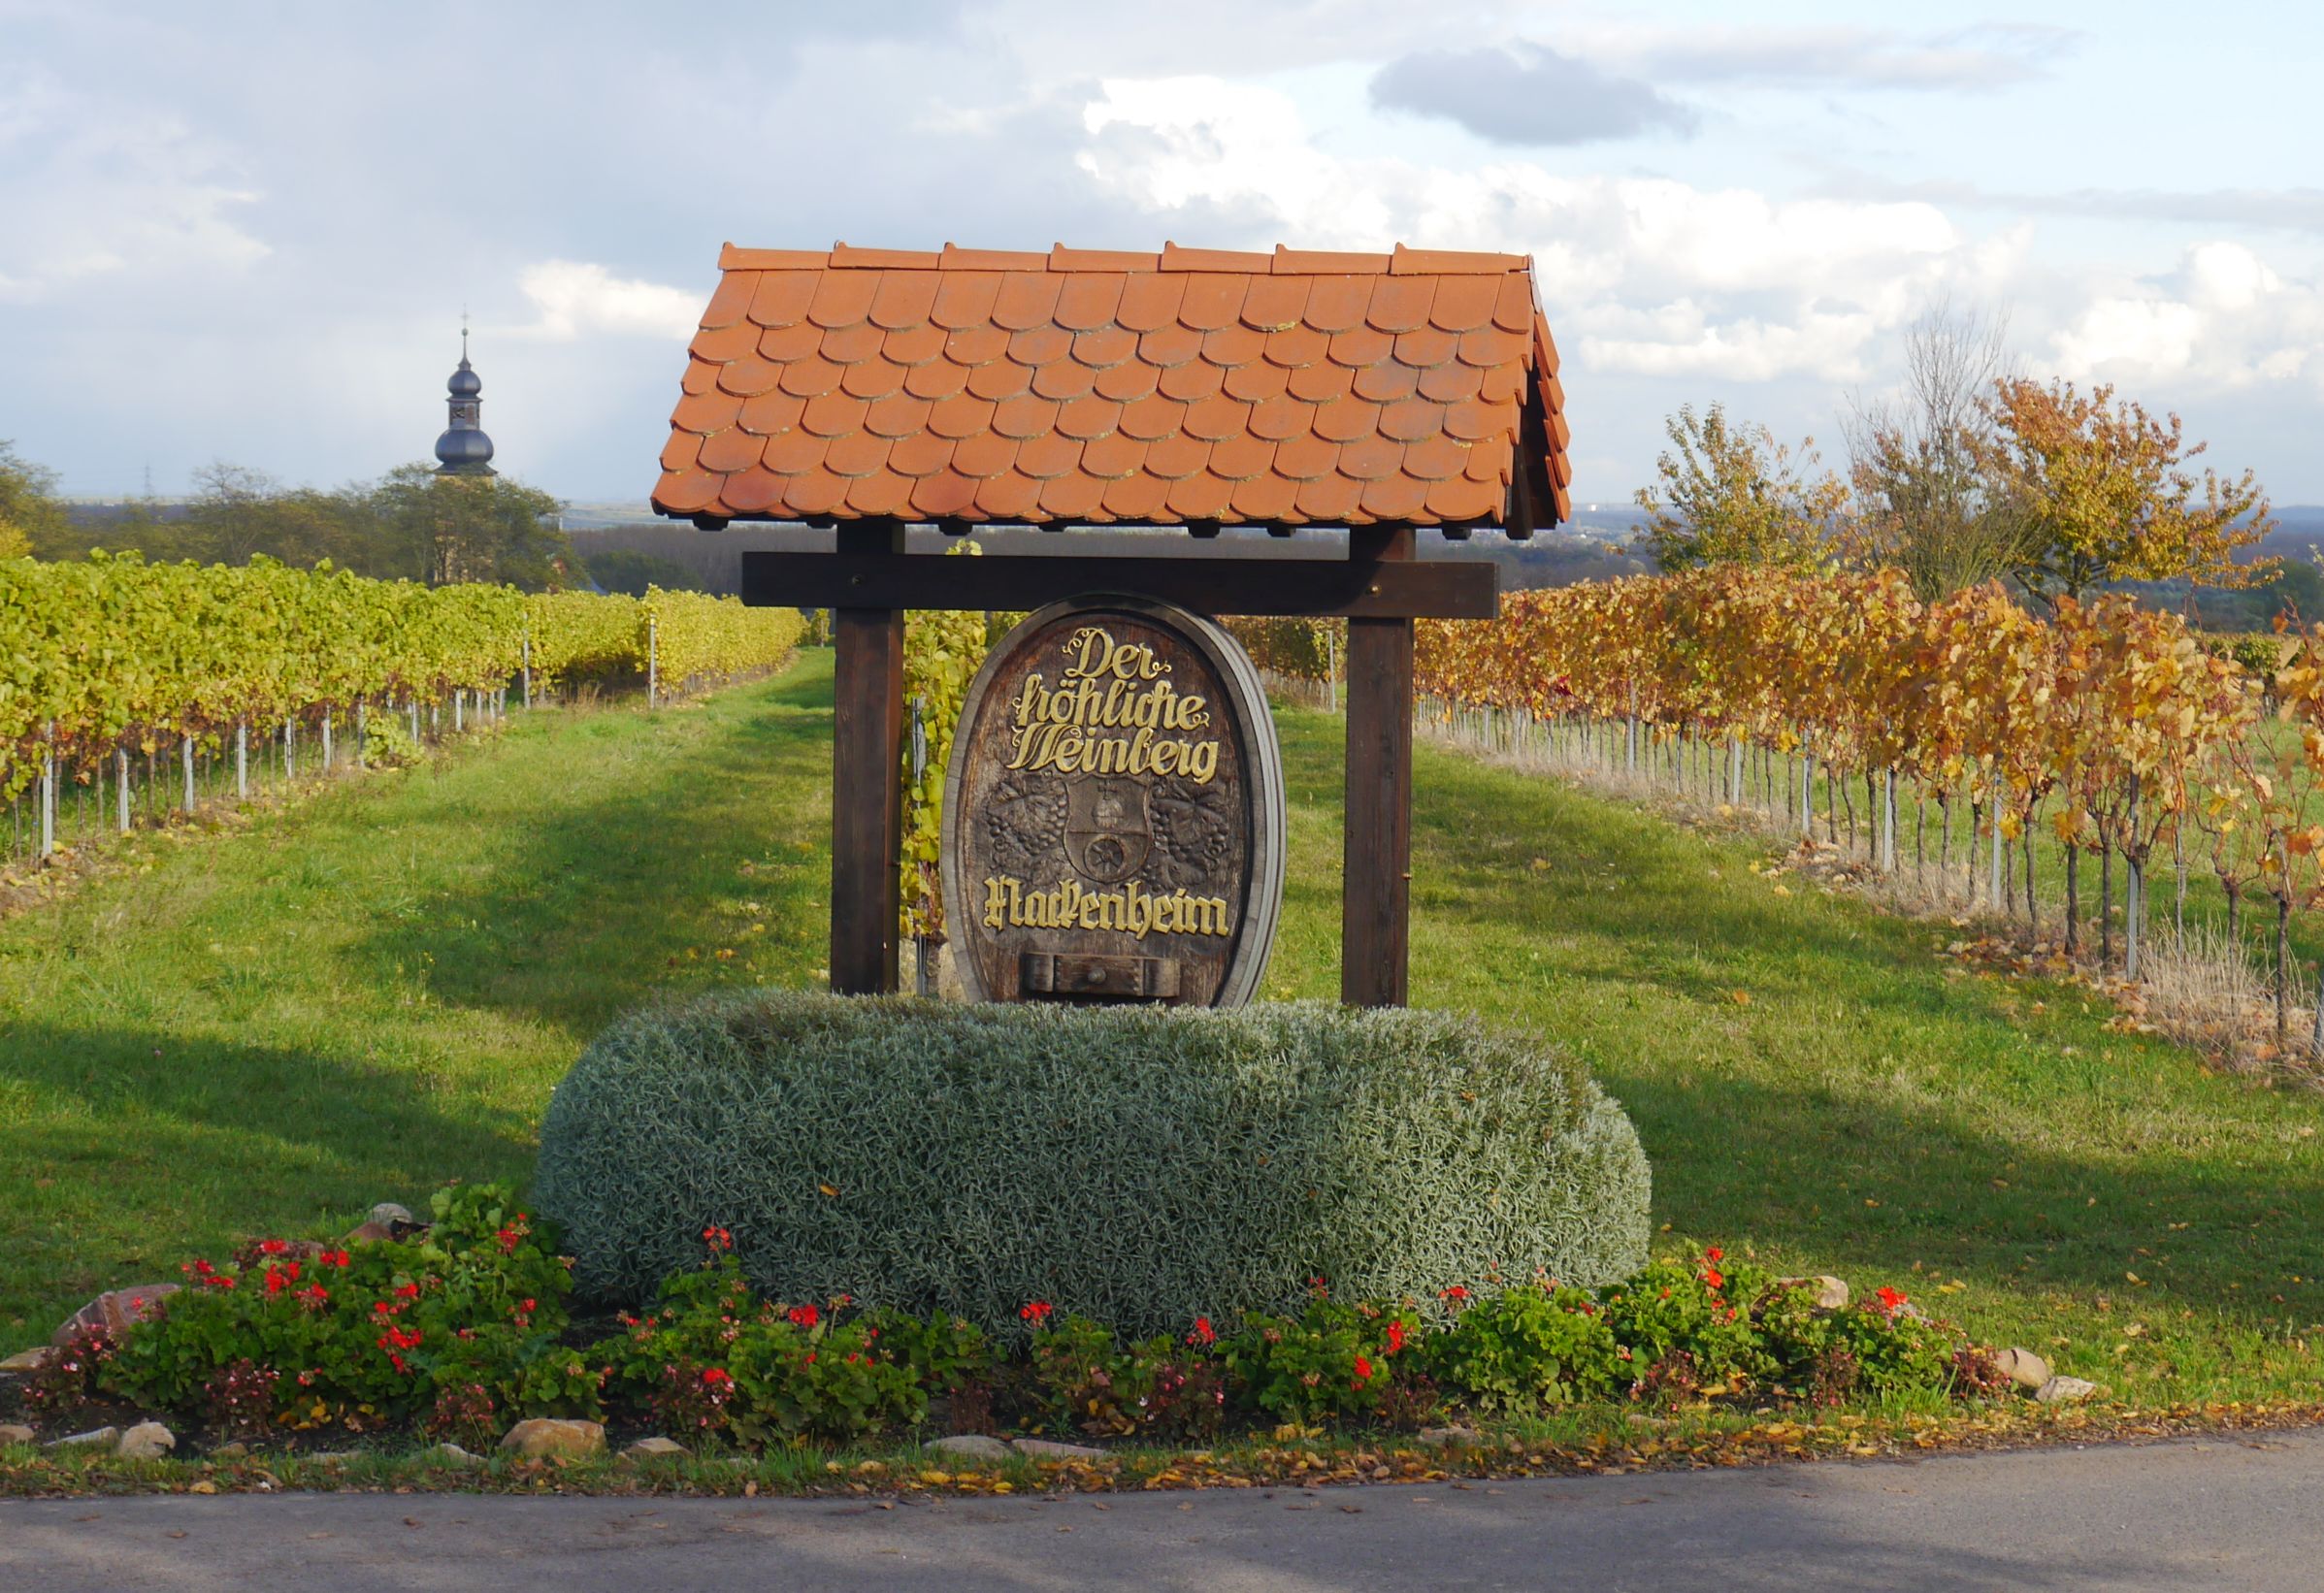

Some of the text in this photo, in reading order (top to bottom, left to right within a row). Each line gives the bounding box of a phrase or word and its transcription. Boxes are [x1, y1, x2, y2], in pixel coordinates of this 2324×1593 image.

[1063, 627, 1172, 680] Der
[1012, 673, 1210, 731] fröhliche
[1006, 724, 1220, 785] Weinberg
[983, 874, 1229, 940] Nackenheim
